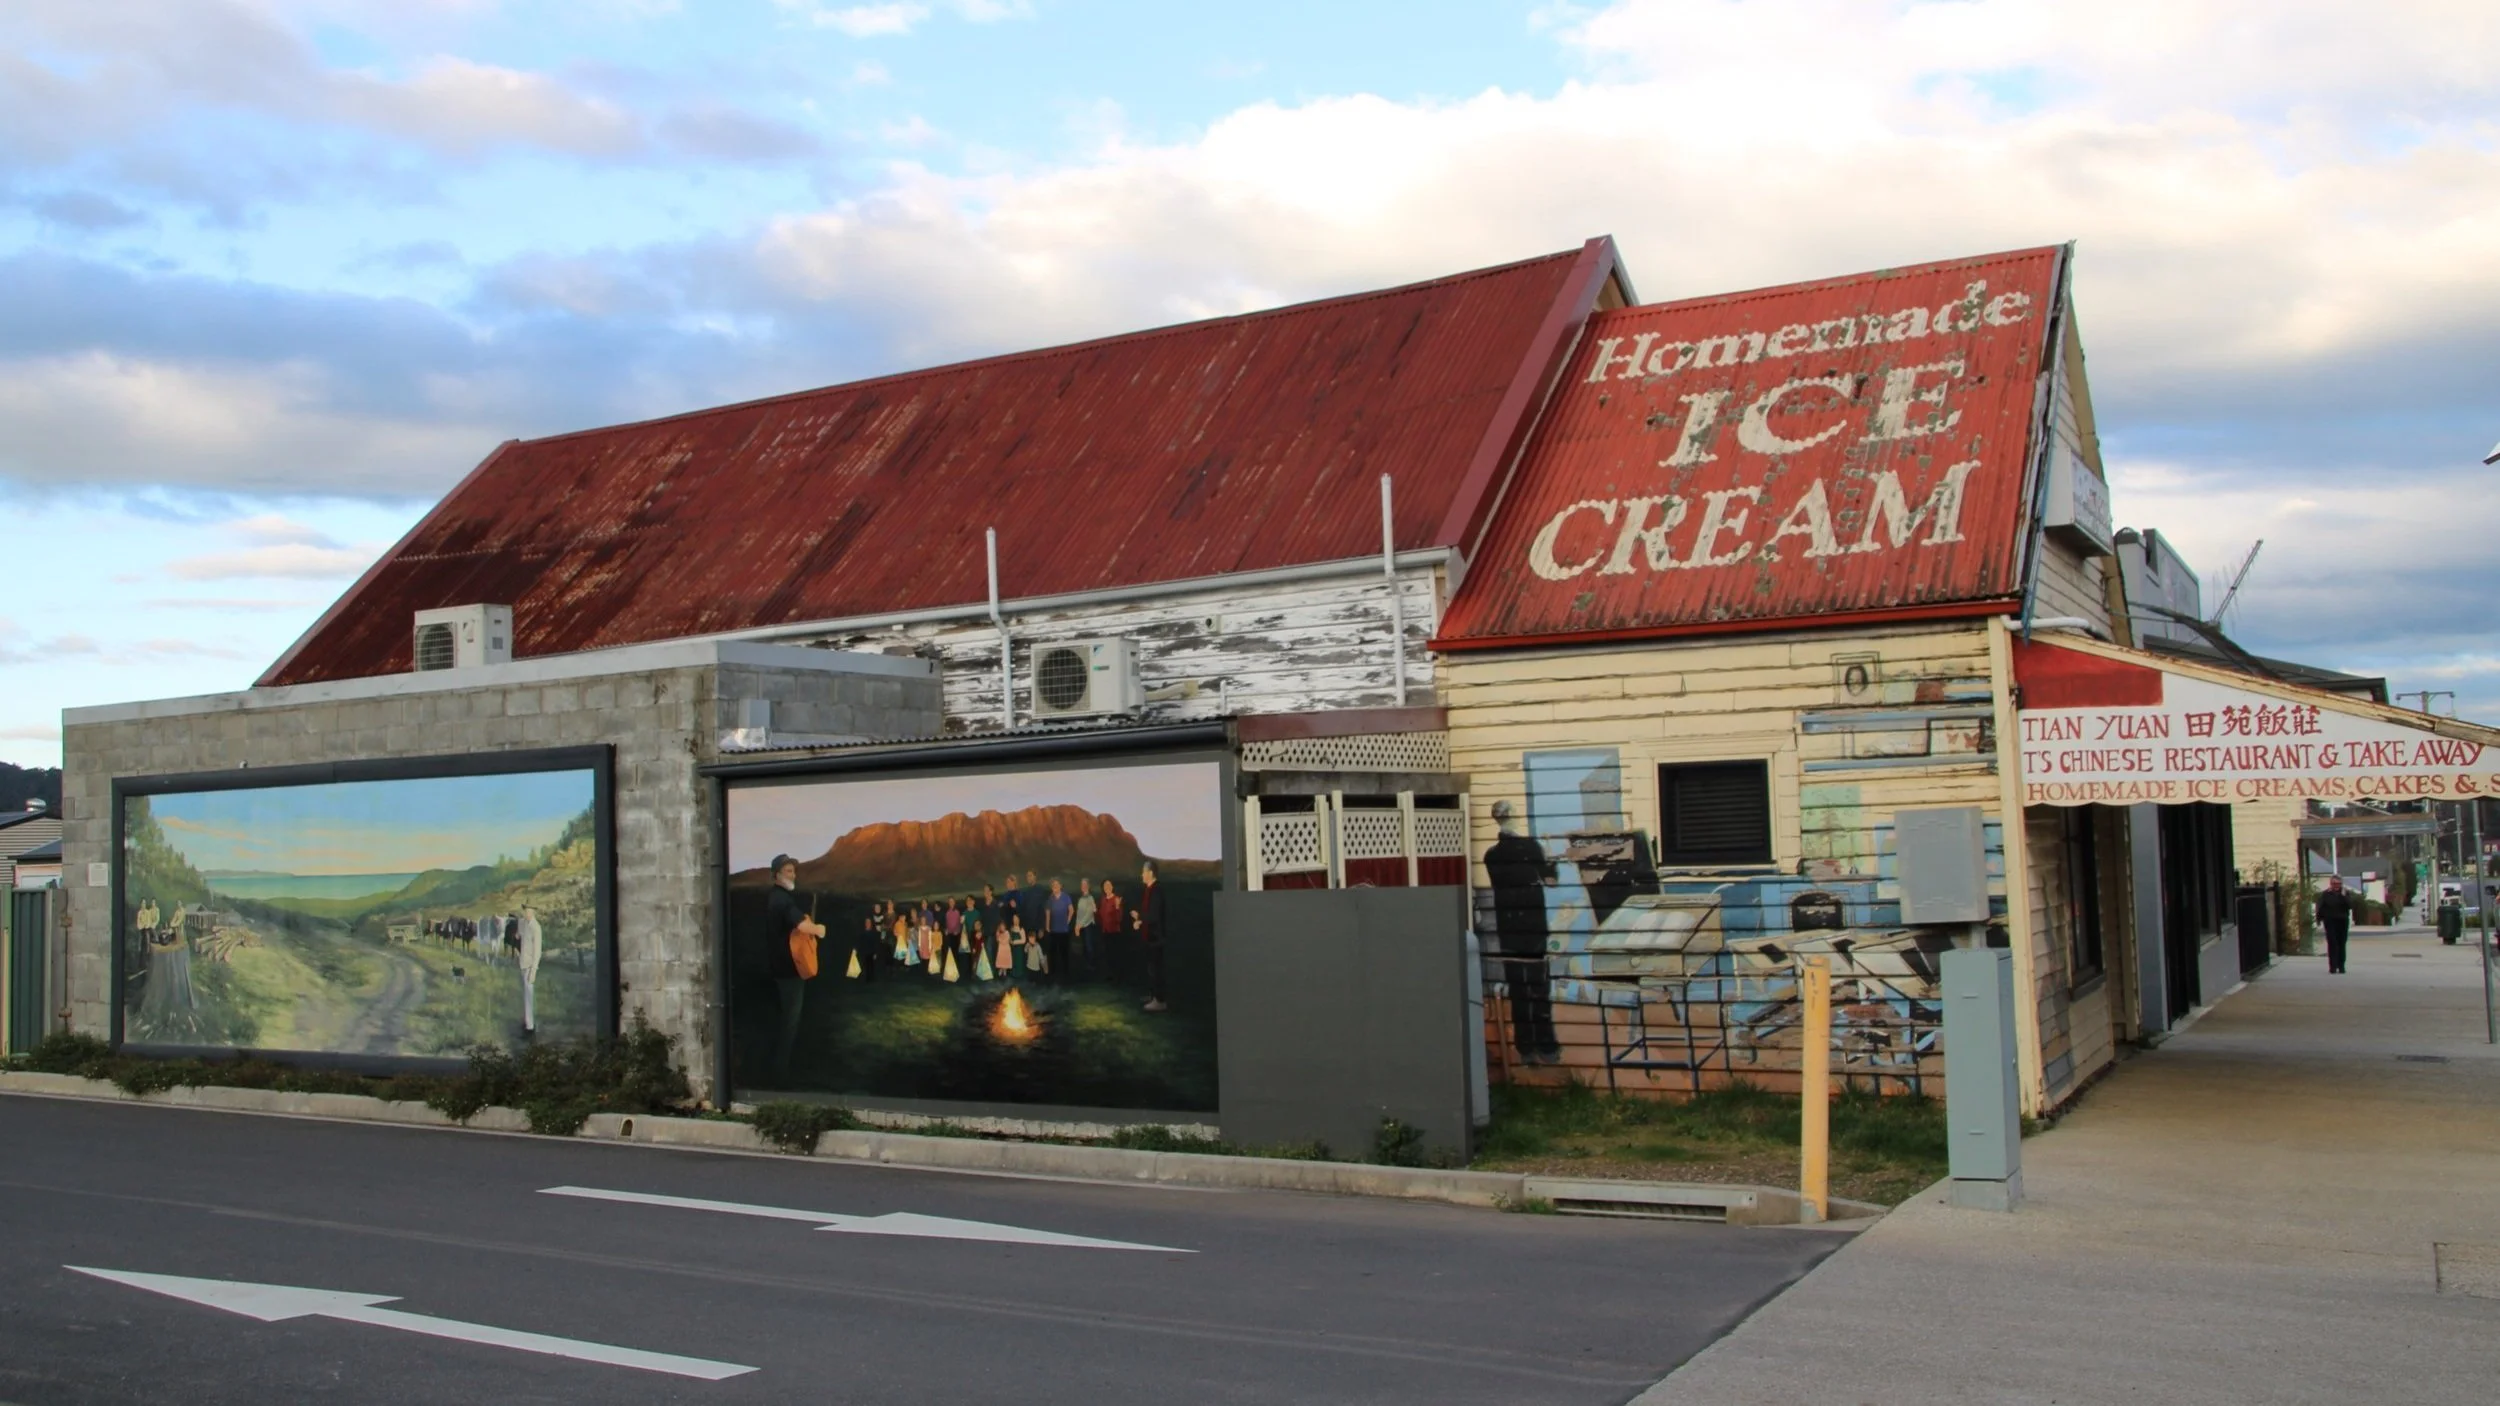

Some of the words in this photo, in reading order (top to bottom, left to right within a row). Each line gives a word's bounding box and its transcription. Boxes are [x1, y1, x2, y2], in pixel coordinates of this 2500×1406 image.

[1584, 280, 2030, 384] Homemade
[1660, 359, 1965, 467] ICE
[1529, 459, 1982, 582] CREAM
[2022, 715, 2084, 742] TIAN
[2096, 714, 2170, 740] YUAN
[2059, 748, 2154, 773] CHINESE
[2165, 744, 2315, 772] RESTAURANT
[2318, 743, 2342, 769] &
[2344, 741, 2408, 768] TAKE
[2411, 739, 2486, 766] AWAY
[2027, 781, 2177, 801] HOMEMADE
[2186, 779, 2229, 799] ICE
[2356, 773, 2446, 796] CAKES
[2455, 774, 2482, 794] &
